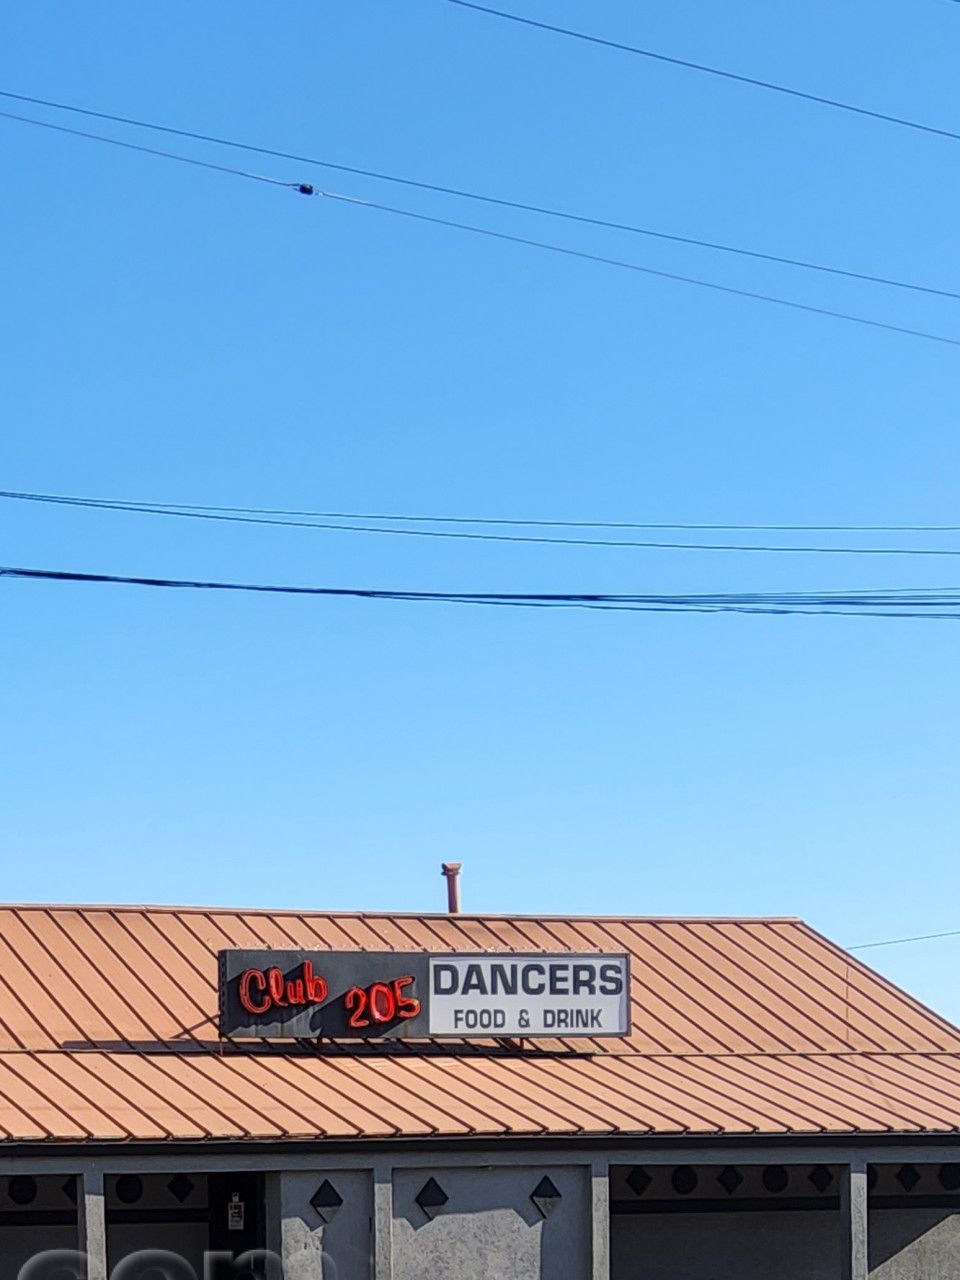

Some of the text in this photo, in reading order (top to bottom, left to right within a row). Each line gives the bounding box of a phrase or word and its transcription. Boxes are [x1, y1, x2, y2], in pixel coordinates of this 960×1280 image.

[239, 959, 422, 1027] Club 205
[433, 963, 623, 996] DANCERS
[454, 1008, 602, 1029] FOOD & DRINK
